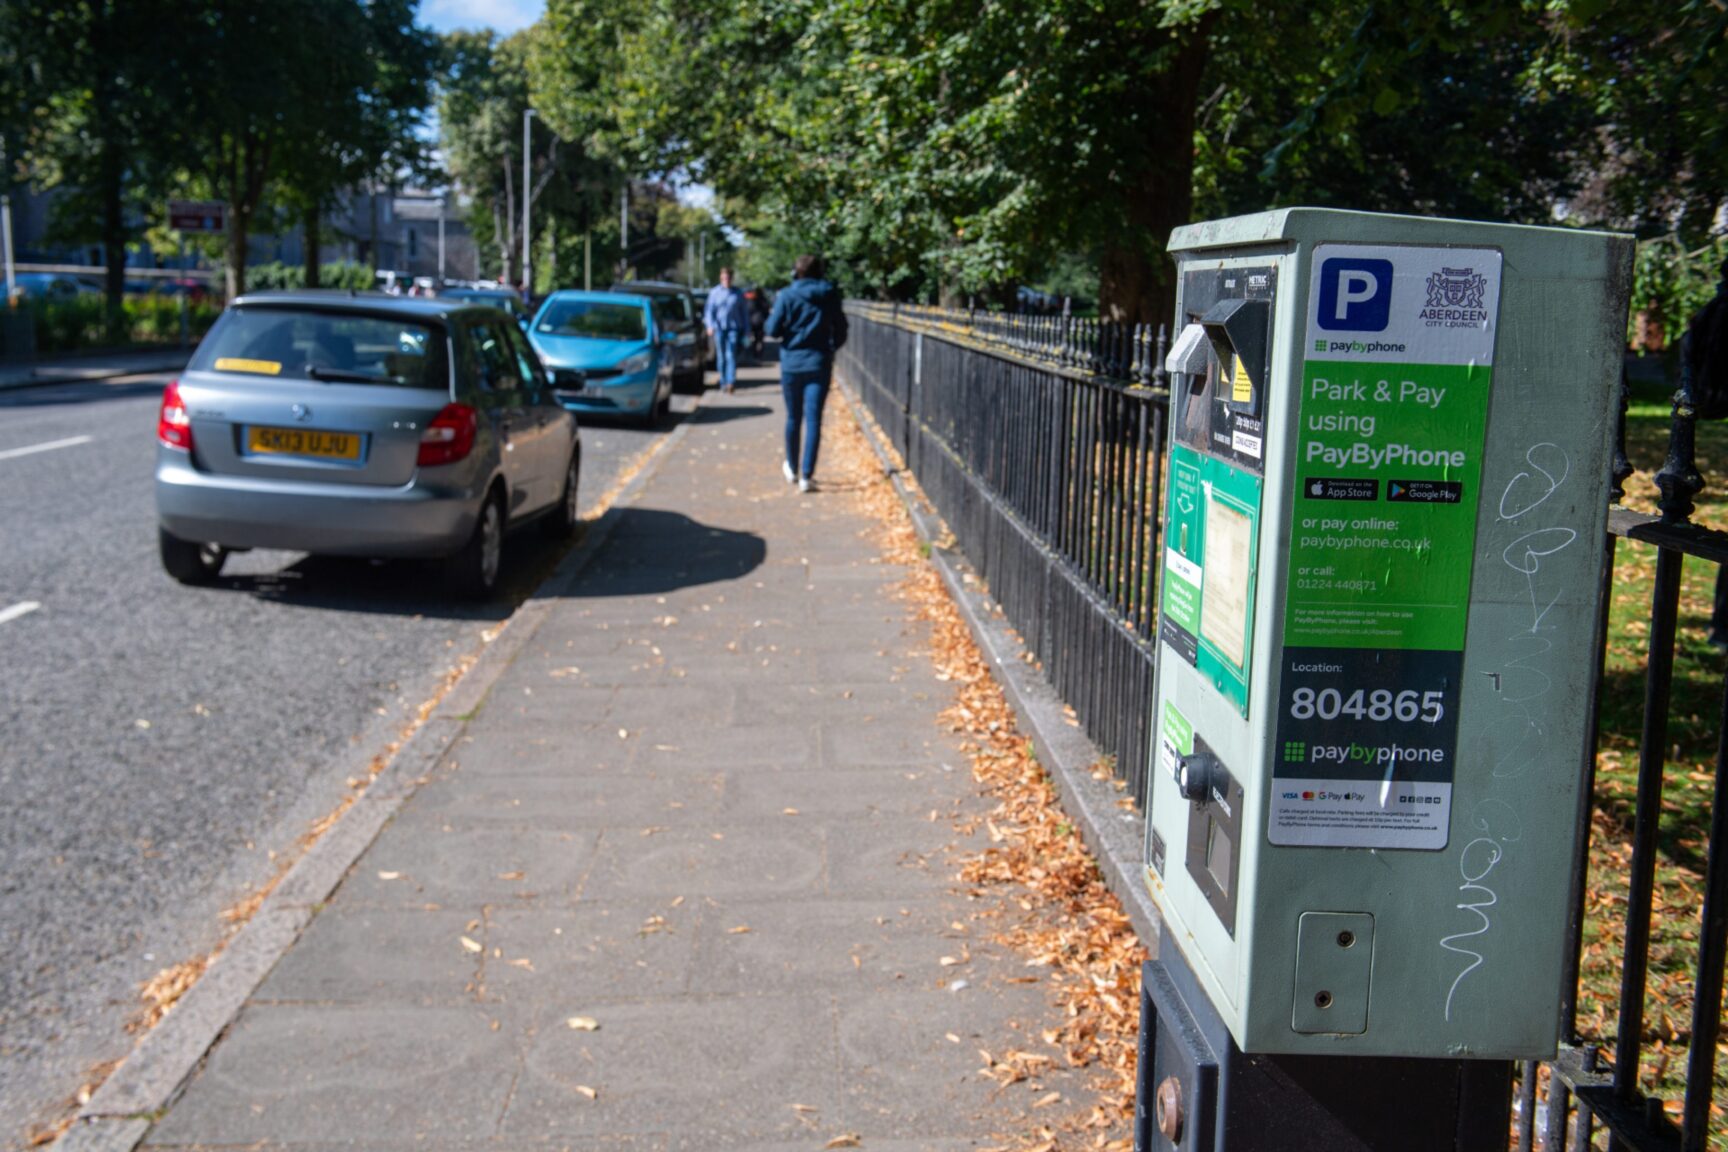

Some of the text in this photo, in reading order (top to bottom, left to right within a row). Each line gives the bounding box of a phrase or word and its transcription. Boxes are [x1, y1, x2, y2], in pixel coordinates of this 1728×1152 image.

[1335, 269, 1378, 320] P
[1419, 309, 1488, 322] ABERDEEN
[1445, 321, 1479, 329] COUNCIL
[1330, 340, 1406, 354] paybyphone
[1311, 378, 1446, 409] Park & Pay
[1309, 410, 1375, 437] using
[1306, 441, 1466, 470] PayByPhone
[1327, 487, 1372, 498] App Store
[1409, 489, 1457, 501] Google Play
[1302, 517, 1399, 532] or pay online:
[1300, 534, 1431, 550] paybyphone.co.uk
[1298, 566, 1335, 576] or call:
[1297, 578, 1332, 590] 01224
[1292, 662, 1343, 673] Location:
[1290, 687, 1444, 723] 804865
[1311, 742, 1444, 765] paybyphone
[1328, 792, 1343, 802] Pay
[1352, 792, 1365, 802] Pay
